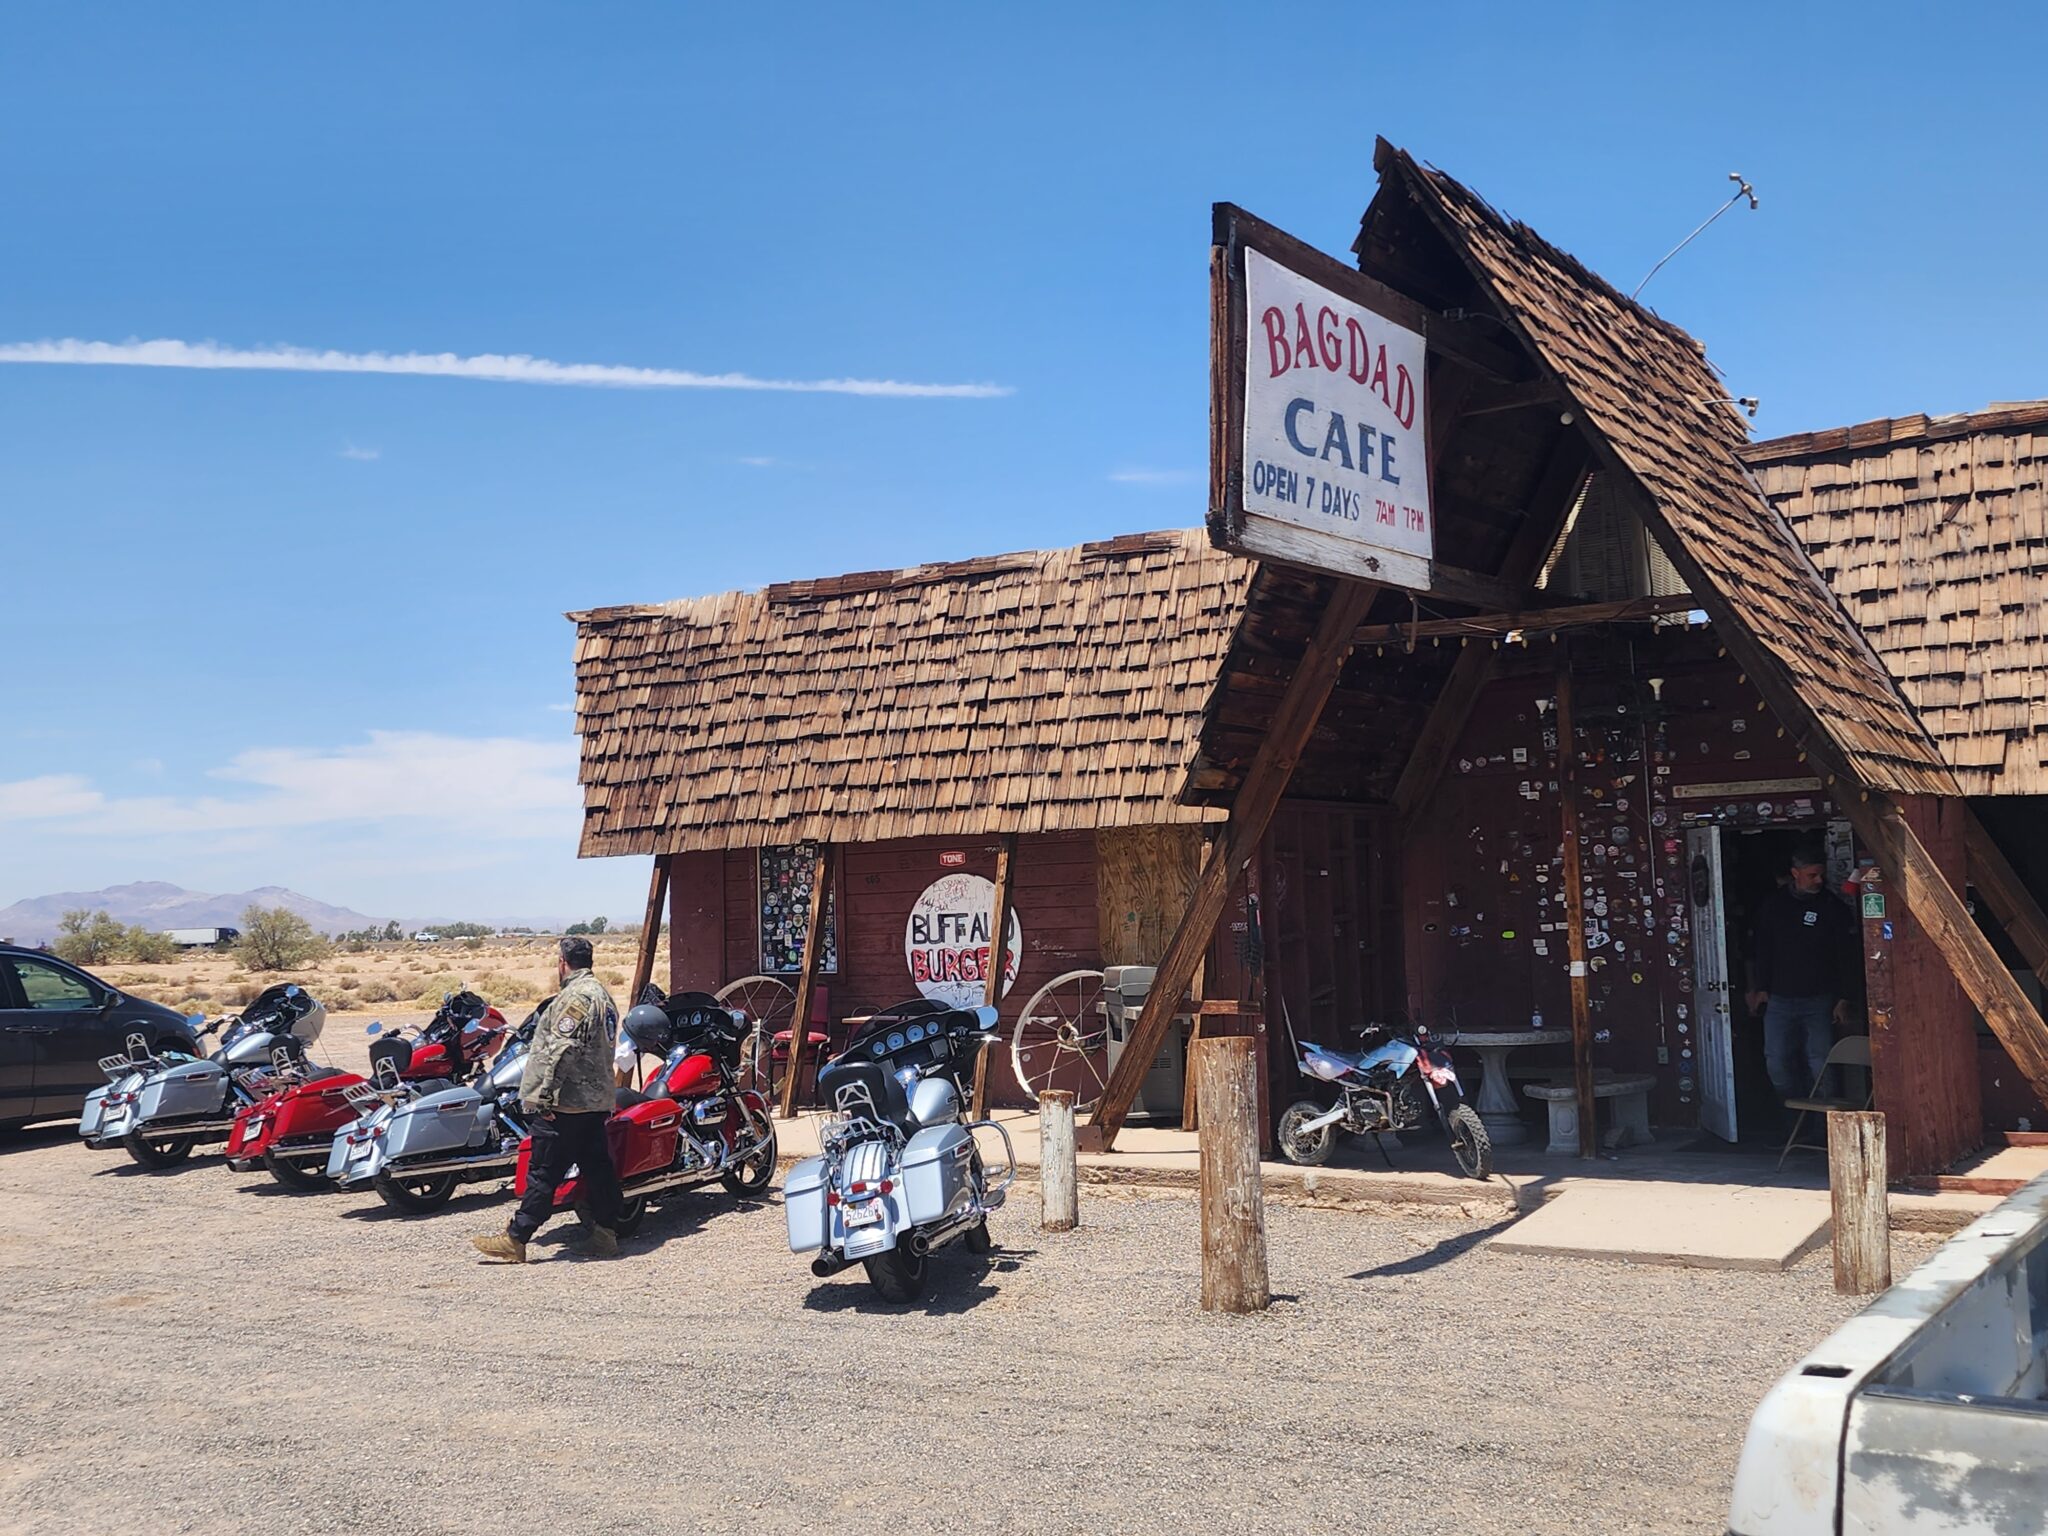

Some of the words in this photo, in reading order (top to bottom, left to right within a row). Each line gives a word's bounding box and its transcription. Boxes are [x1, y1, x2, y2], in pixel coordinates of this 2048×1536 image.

[1261, 302, 1415, 430] BAGDAD
[1284, 397, 1400, 485] CAFE
[1253, 460, 1297, 505] OPEN
[1306, 477, 1315, 509] 7
[1322, 482, 1360, 521] DAYS
[1375, 499, 1395, 527] 7AM
[1403, 506, 1425, 532] 7PM
[942, 854, 963, 864] TONE
